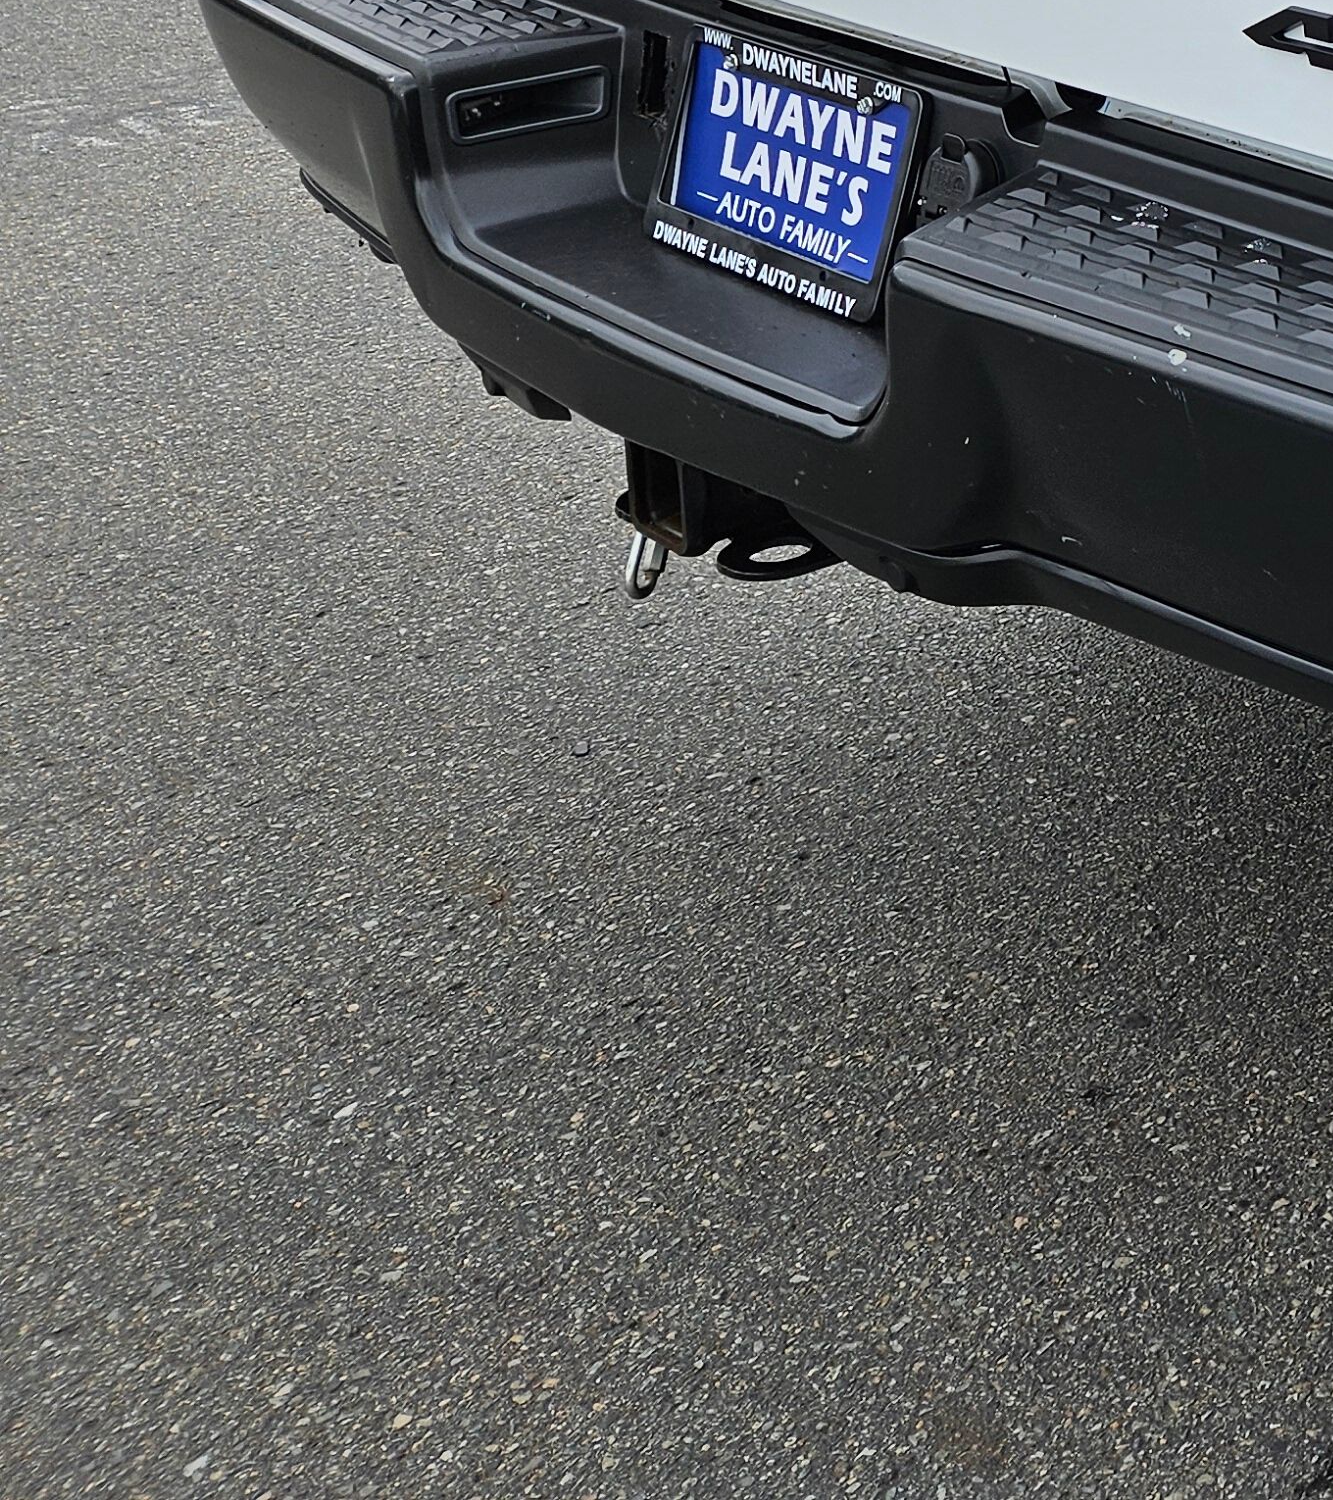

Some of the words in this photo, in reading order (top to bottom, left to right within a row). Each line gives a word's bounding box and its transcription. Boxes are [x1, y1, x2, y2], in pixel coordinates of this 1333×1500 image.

[710, 67, 897, 175] DWAYNE
[742, 43, 858, 100] DWAYNELANE
[873, 80, 903, 103] .COM
[720, 131, 869, 227] LANE'S
[652, 220, 706, 258] DWAYNE
[709, 243, 757, 279] LANE'S
[756, 263, 797, 294] AUTO
[797, 279, 857, 319] FAMILY
[716, 192, 776, 233] AUTO
[779, 214, 853, 265] FAMILY
